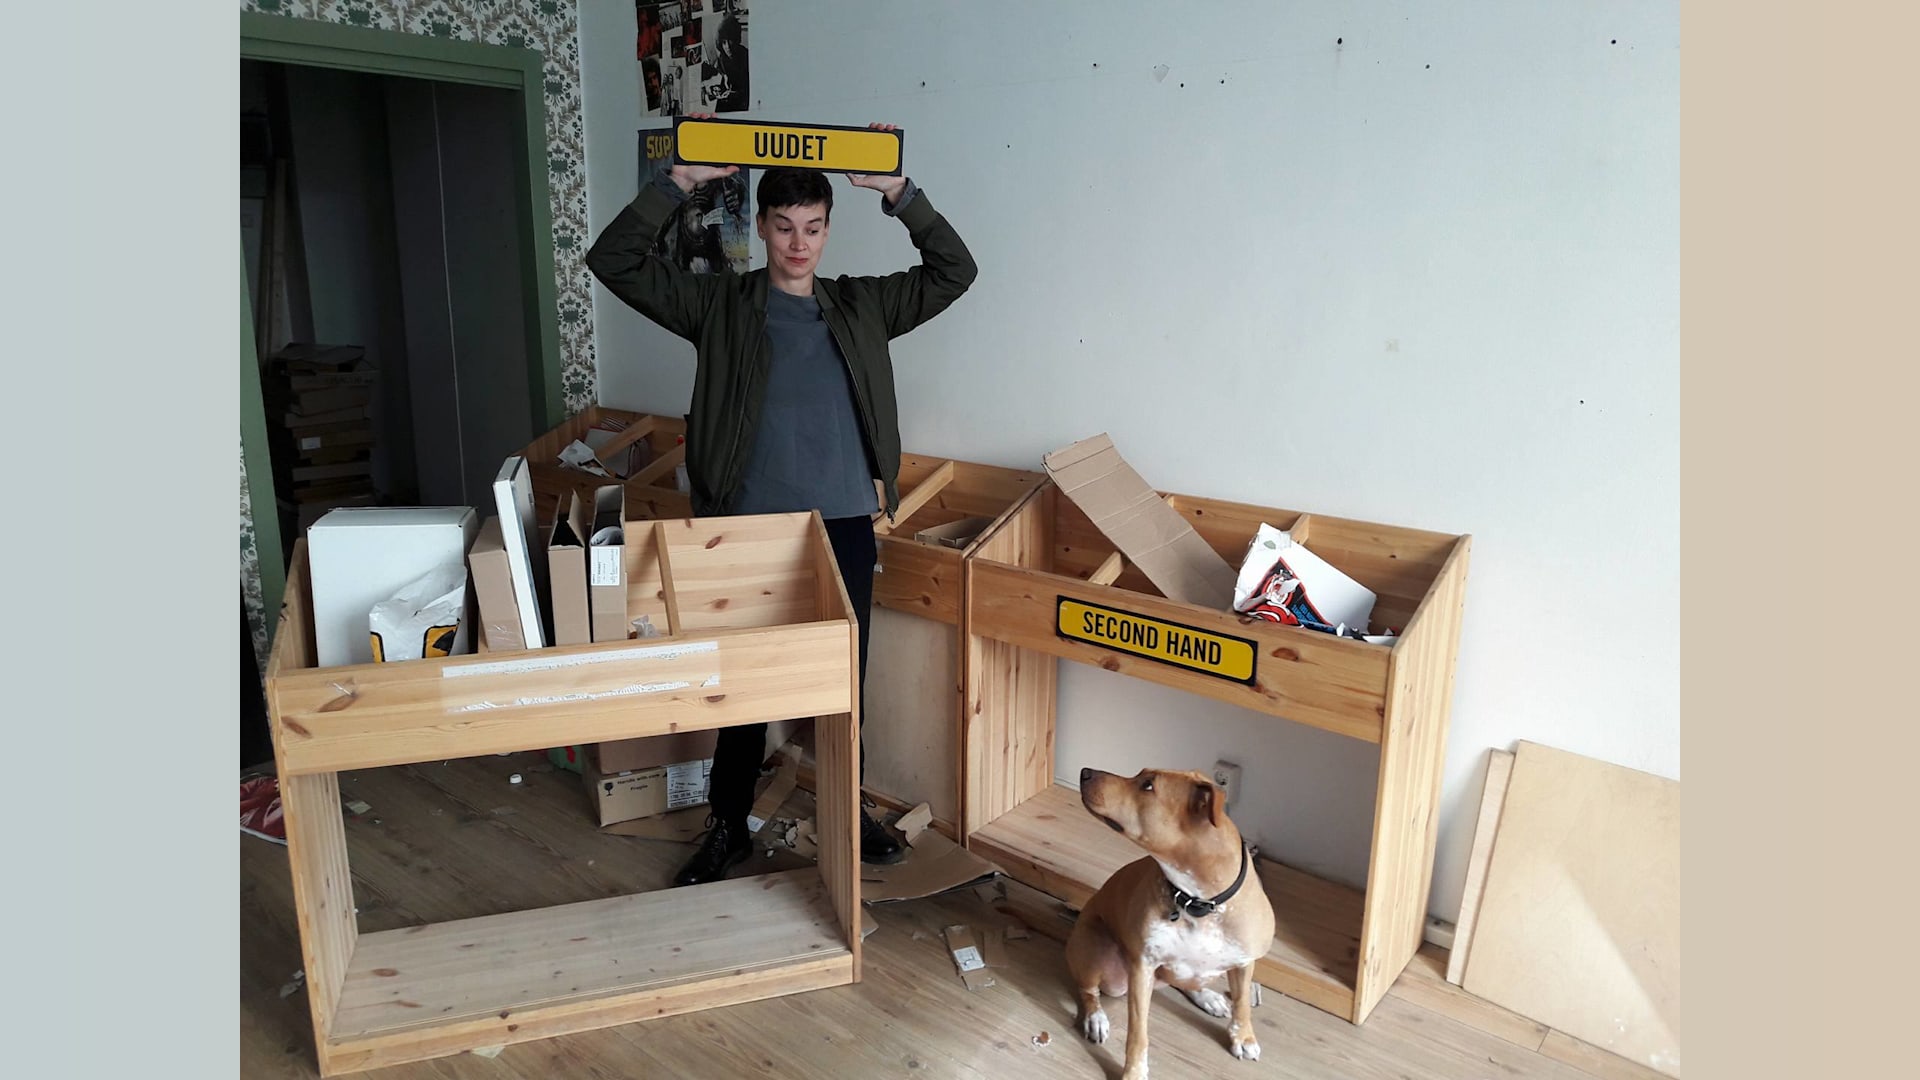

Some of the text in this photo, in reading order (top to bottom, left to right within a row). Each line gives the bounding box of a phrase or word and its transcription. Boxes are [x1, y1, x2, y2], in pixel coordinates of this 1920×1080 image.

[754, 132, 827, 161] UUDET
[1083, 611, 1221, 665] SECOND HAND
